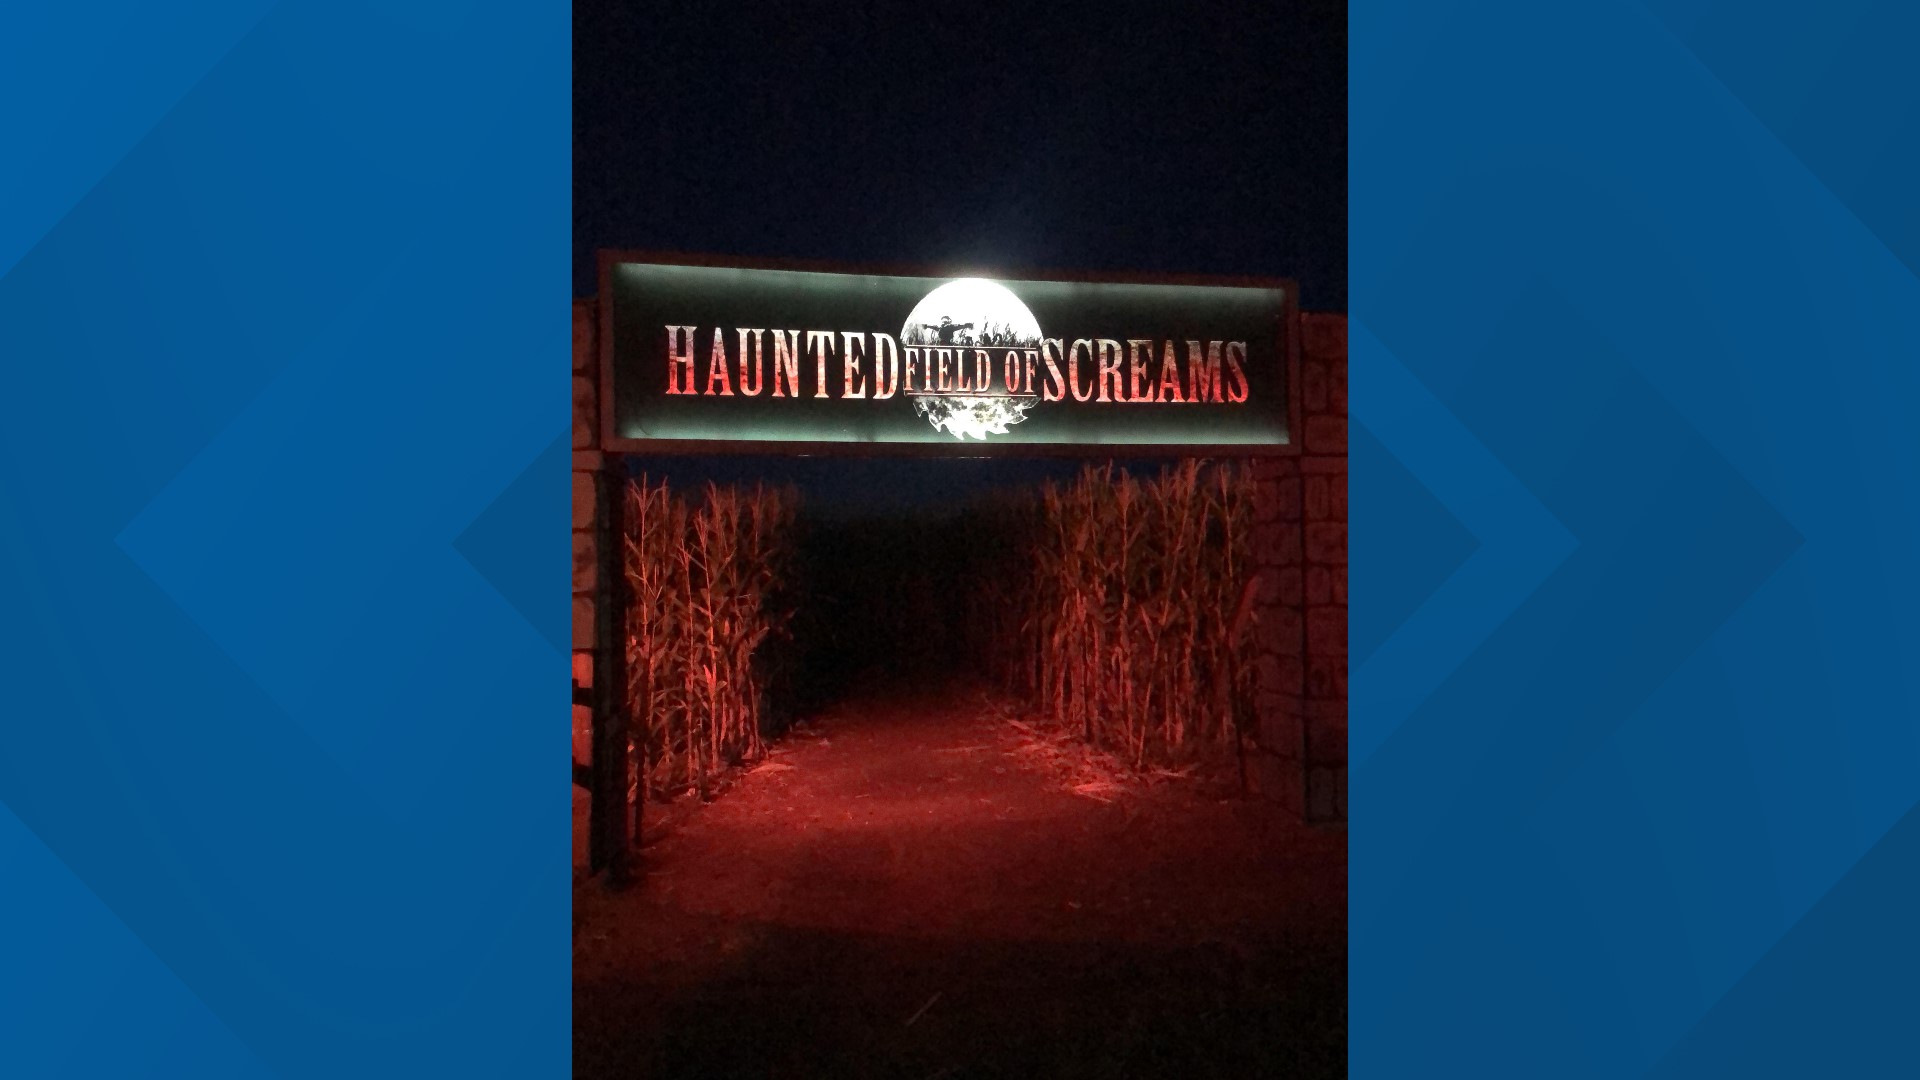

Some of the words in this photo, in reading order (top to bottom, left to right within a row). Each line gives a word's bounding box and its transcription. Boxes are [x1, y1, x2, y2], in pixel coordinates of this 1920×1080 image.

[665, 325, 899, 400] HAUNTED
[903, 347, 991, 393] FIELD
[1004, 350, 1040, 393] OF
[1042, 337, 1249, 403] SCREAMS
